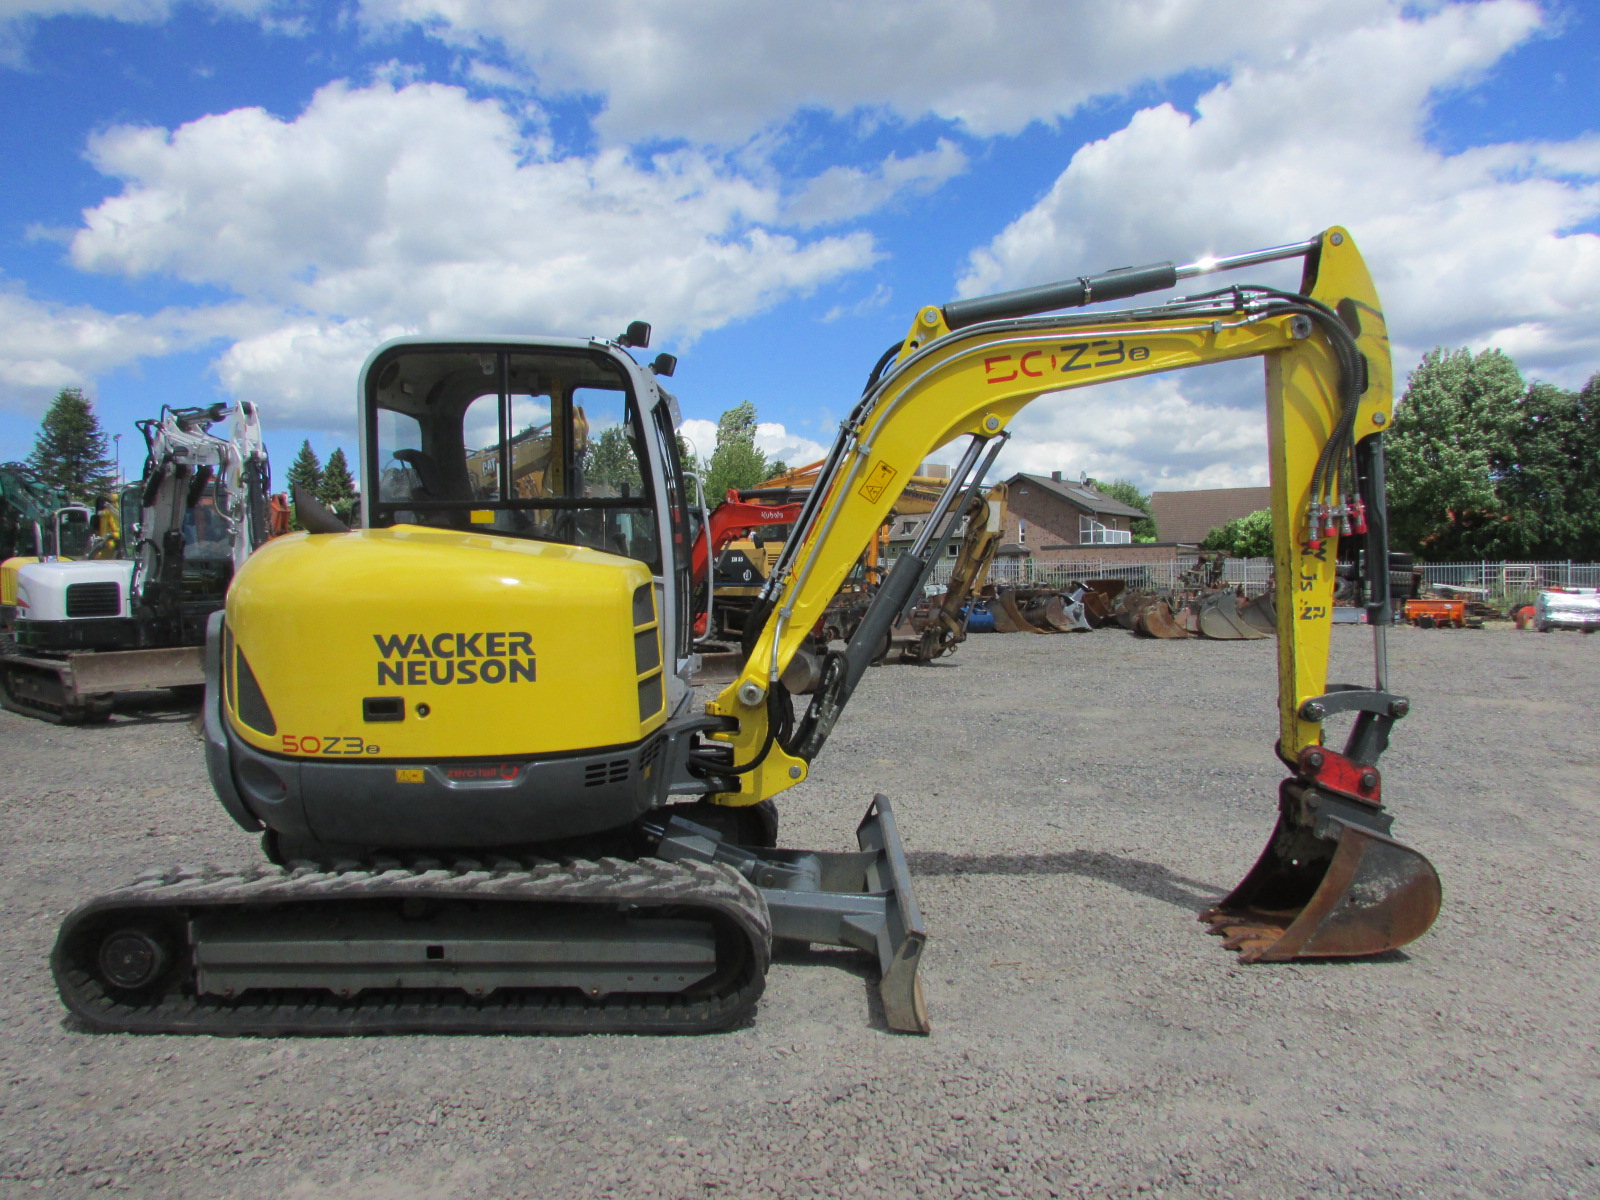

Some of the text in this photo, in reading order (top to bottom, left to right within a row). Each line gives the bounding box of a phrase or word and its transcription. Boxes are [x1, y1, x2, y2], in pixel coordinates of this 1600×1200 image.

[482, 457, 496, 476] CAT
[761, 512, 784, 520] Kubota
[373, 632, 536, 659] WACKER
[378, 659, 536, 686] NEUSON
[447, 769, 476, 778] zero
